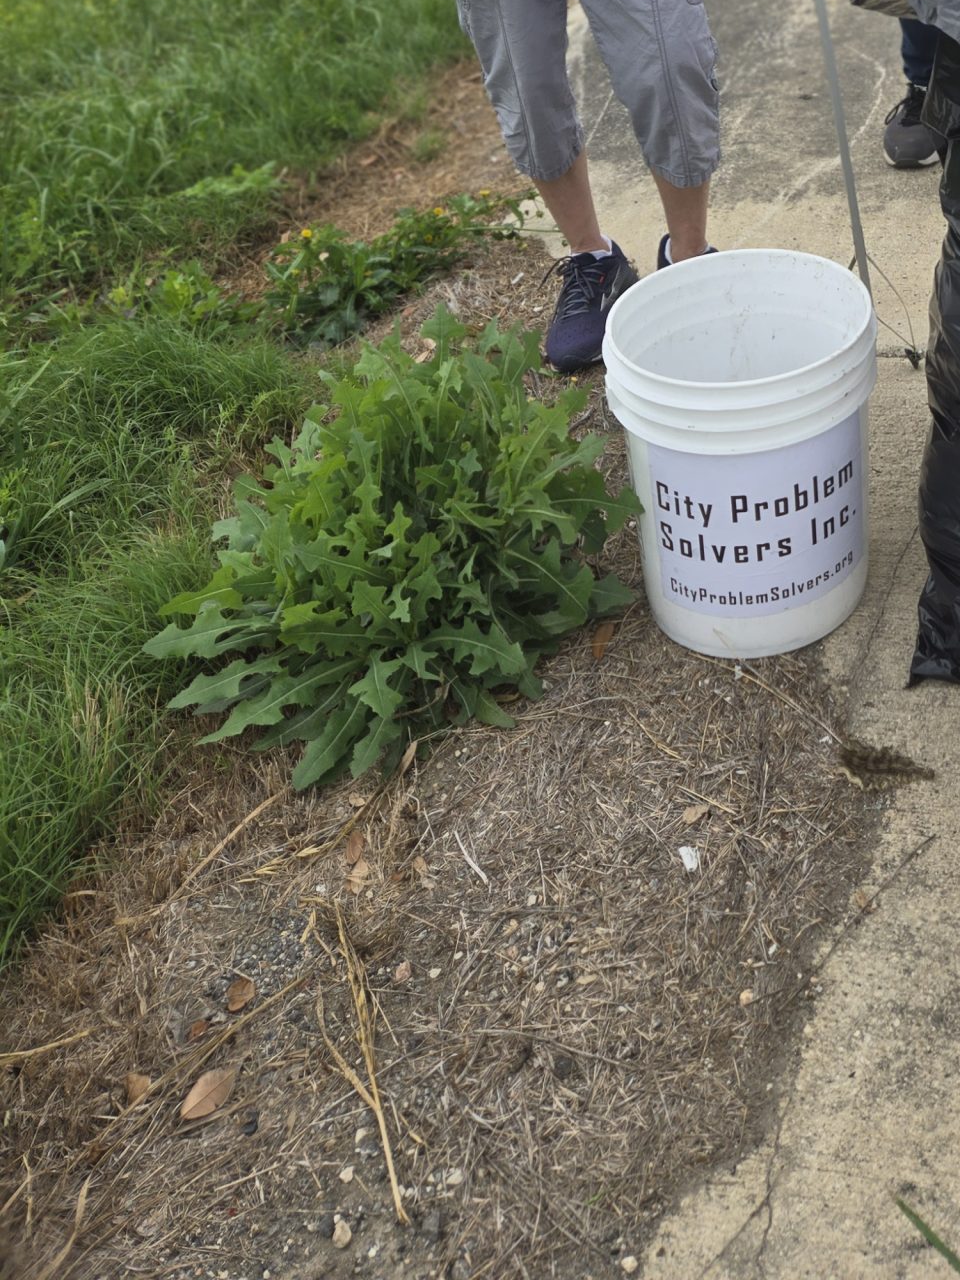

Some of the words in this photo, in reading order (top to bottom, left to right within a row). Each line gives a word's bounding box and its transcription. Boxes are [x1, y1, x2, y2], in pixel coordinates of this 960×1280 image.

[655, 480, 713, 528] City
[730, 460, 854, 523] Problem
[660, 521, 792, 564] Solvers
[811, 504, 857, 545] Inc.
[670, 550, 854, 606] CityProblemSolvers.org
